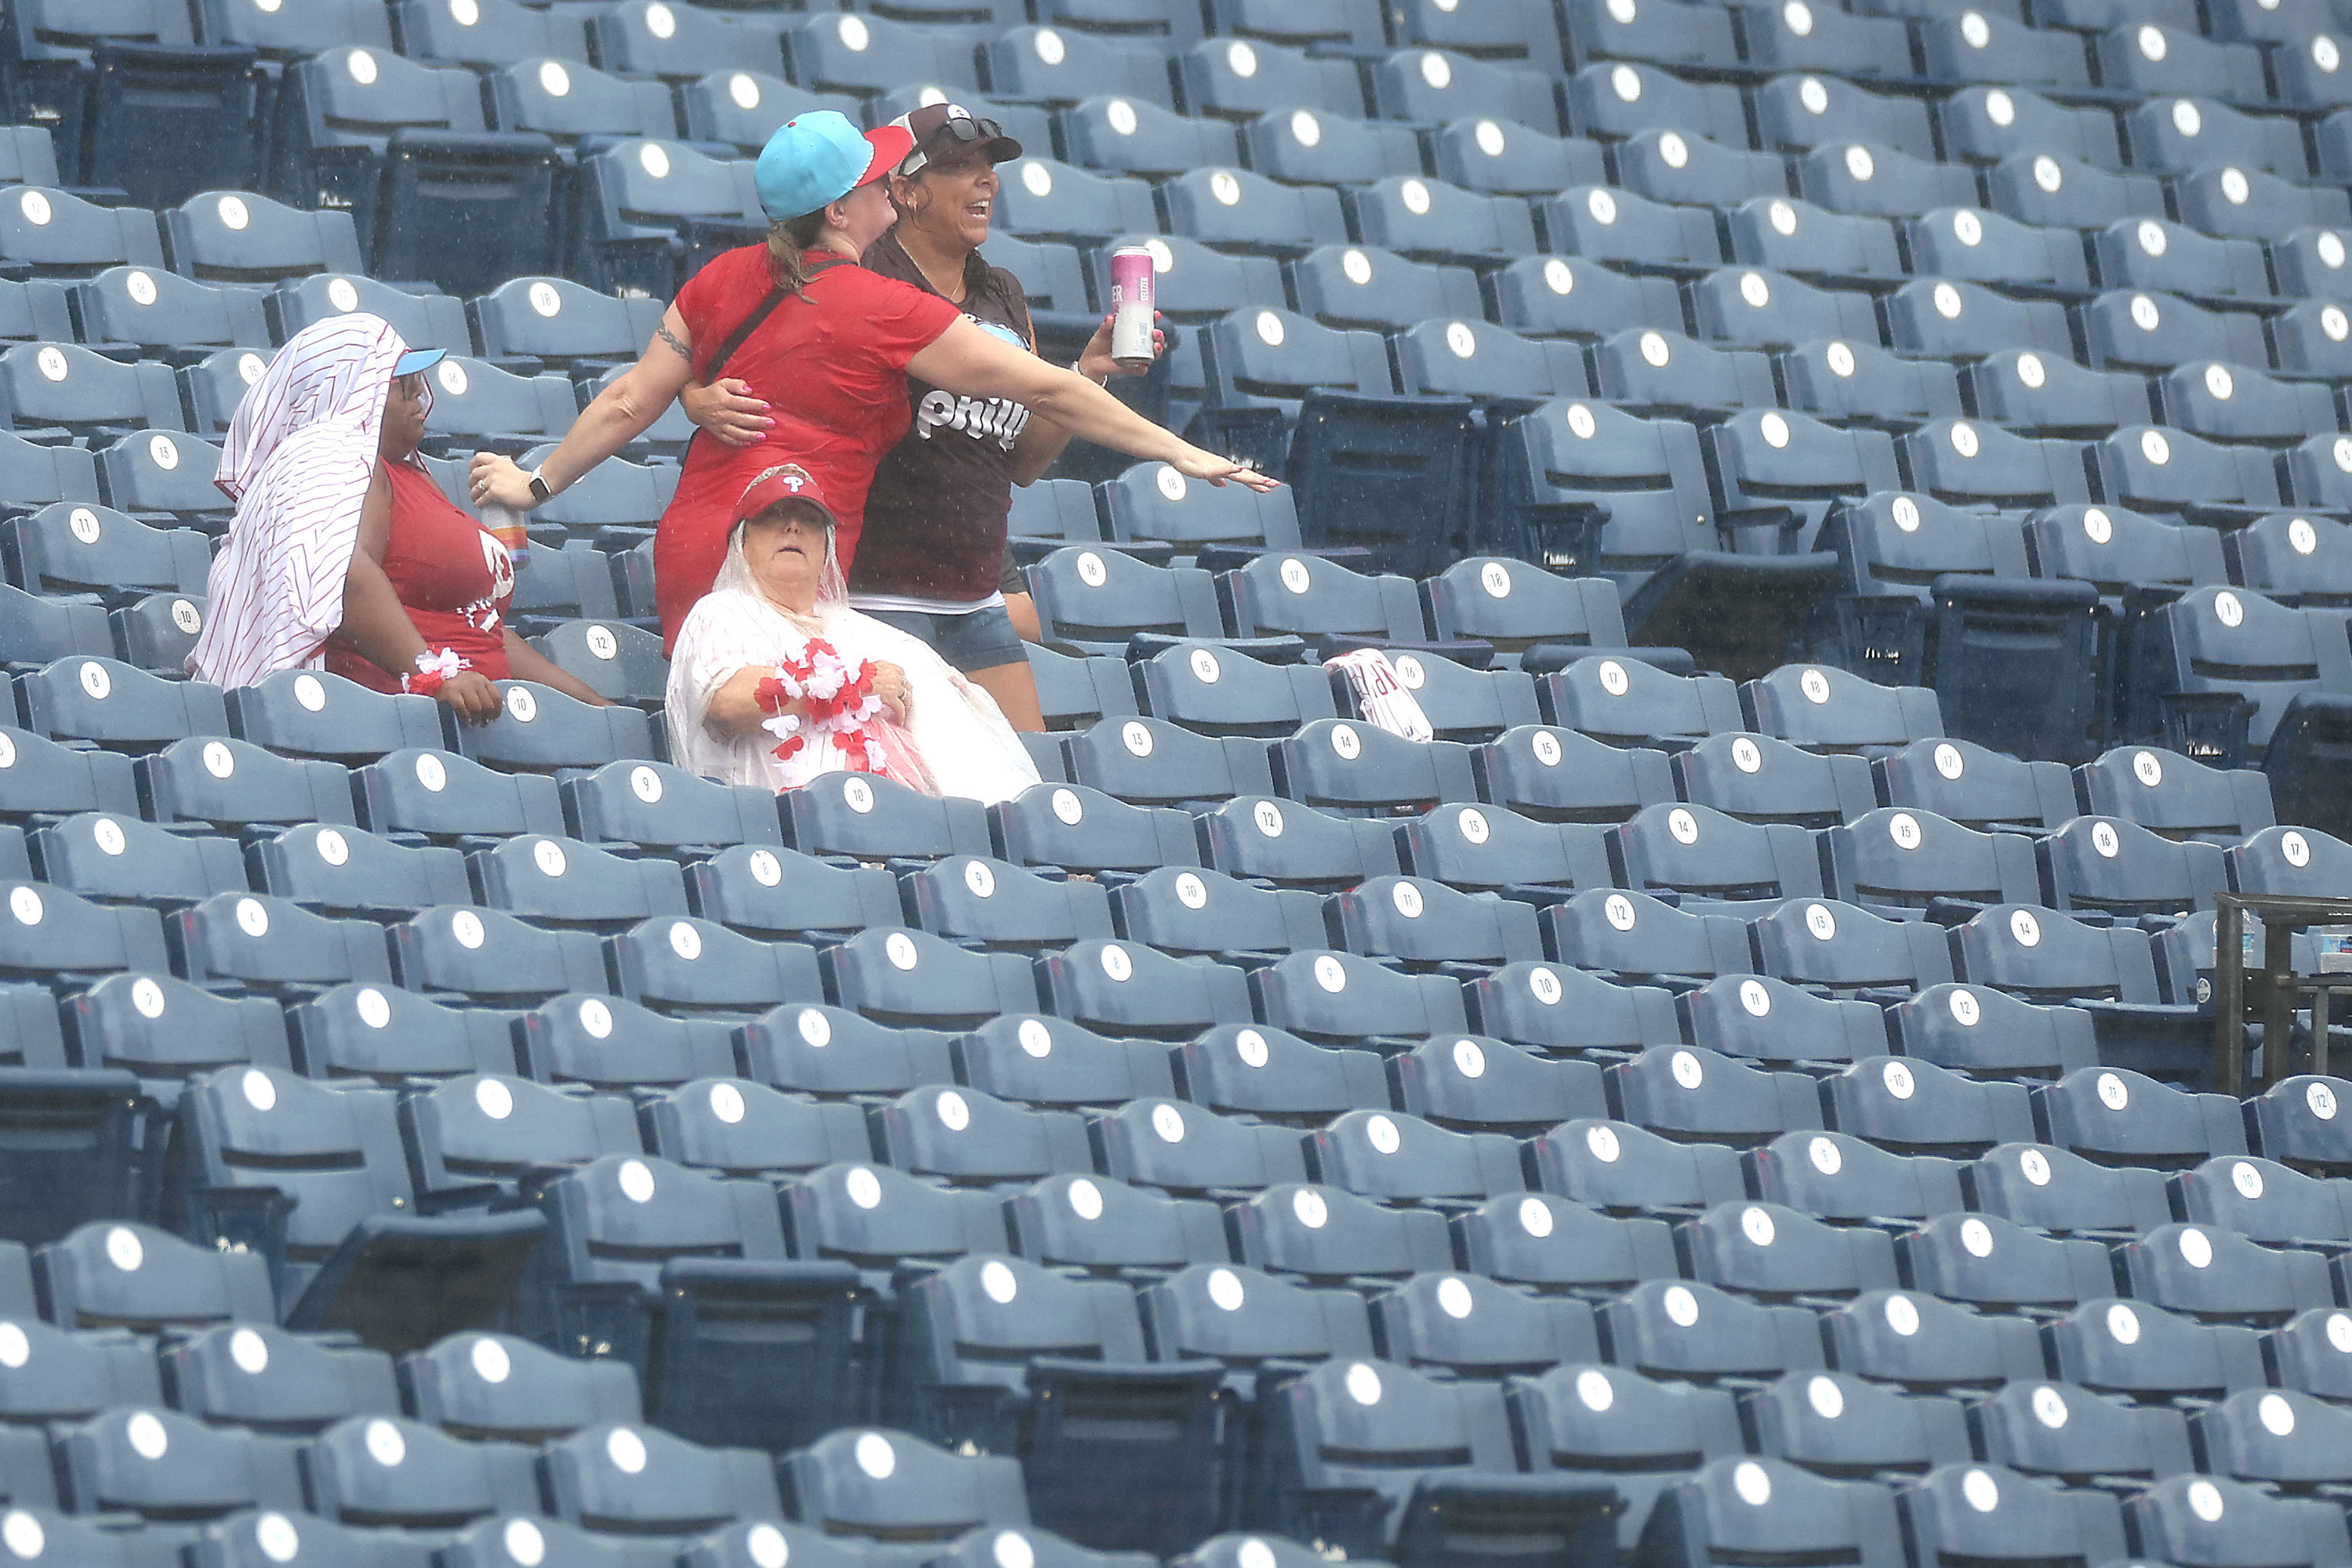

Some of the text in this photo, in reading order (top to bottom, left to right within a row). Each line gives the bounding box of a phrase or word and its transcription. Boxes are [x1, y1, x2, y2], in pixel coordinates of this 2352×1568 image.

[136, 282, 146, 295] 16
[539, 292, 551, 307] 18
[48, 358, 59, 370] 14
[249, 365, 259, 376] 15
[448, 372, 459, 384] 16
[158, 446, 169, 459] 13
[1167, 478, 1178, 490] 18
[1903, 506, 1908, 521] 1
[78, 518, 90, 532] 11
[1087, 564, 1097, 575] 16
[1290, 570, 1299, 583] 17
[1490, 573, 1503, 587] 18
[2226, 602, 2231, 616] 1
[181, 611, 191, 623] 10
[595, 637, 608, 649] 12
[1200, 660, 1211, 673] 15
[1405, 666, 1416, 678] 16
[91, 673, 100, 688] 8
[1608, 672, 1617, 684] 17
[1810, 681, 1820, 694] 18
[516, 698, 527, 711] 10
[1132, 732, 1143, 746] 13
[1341, 735, 1352, 748] 14
[1541, 742, 1552, 754] 15
[216, 753, 221, 767] 7
[1740, 750, 1751, 762] 16
[1944, 755, 1952, 768] 17
[2143, 763, 2153, 776] 18
[642, 776, 649, 791] 9
[853, 789, 864, 802] 10
[1262, 811, 1276, 827] 12
[1468, 820, 1479, 833] 13
[1678, 821, 1689, 833] 14
[1900, 826, 1911, 838] 15
[2100, 833, 2111, 847] 16
[2290, 843, 2299, 856] 17
[546, 852, 552, 865] 7
[975, 871, 982, 886] 9
[1185, 884, 1197, 898] 10
[1403, 894, 1413, 907] 11
[1613, 905, 1627, 920] 12
[1815, 916, 1826, 929] 13
[2020, 923, 2031, 935] 14
[899, 946, 905, 959] 7
[1112, 956, 1120, 970] 8
[1327, 967, 1333, 981] 9
[1538, 978, 1552, 994] 10
[1750, 993, 1760, 1005] 11
[1959, 1001, 1971, 1014] 12
[1250, 1042, 1255, 1054] 7
[1893, 1073, 1904, 1087] 10
[2108, 1086, 2117, 1098] 11
[2316, 1094, 2328, 1108] 12
[2242, 1174, 2253, 1187] 10
